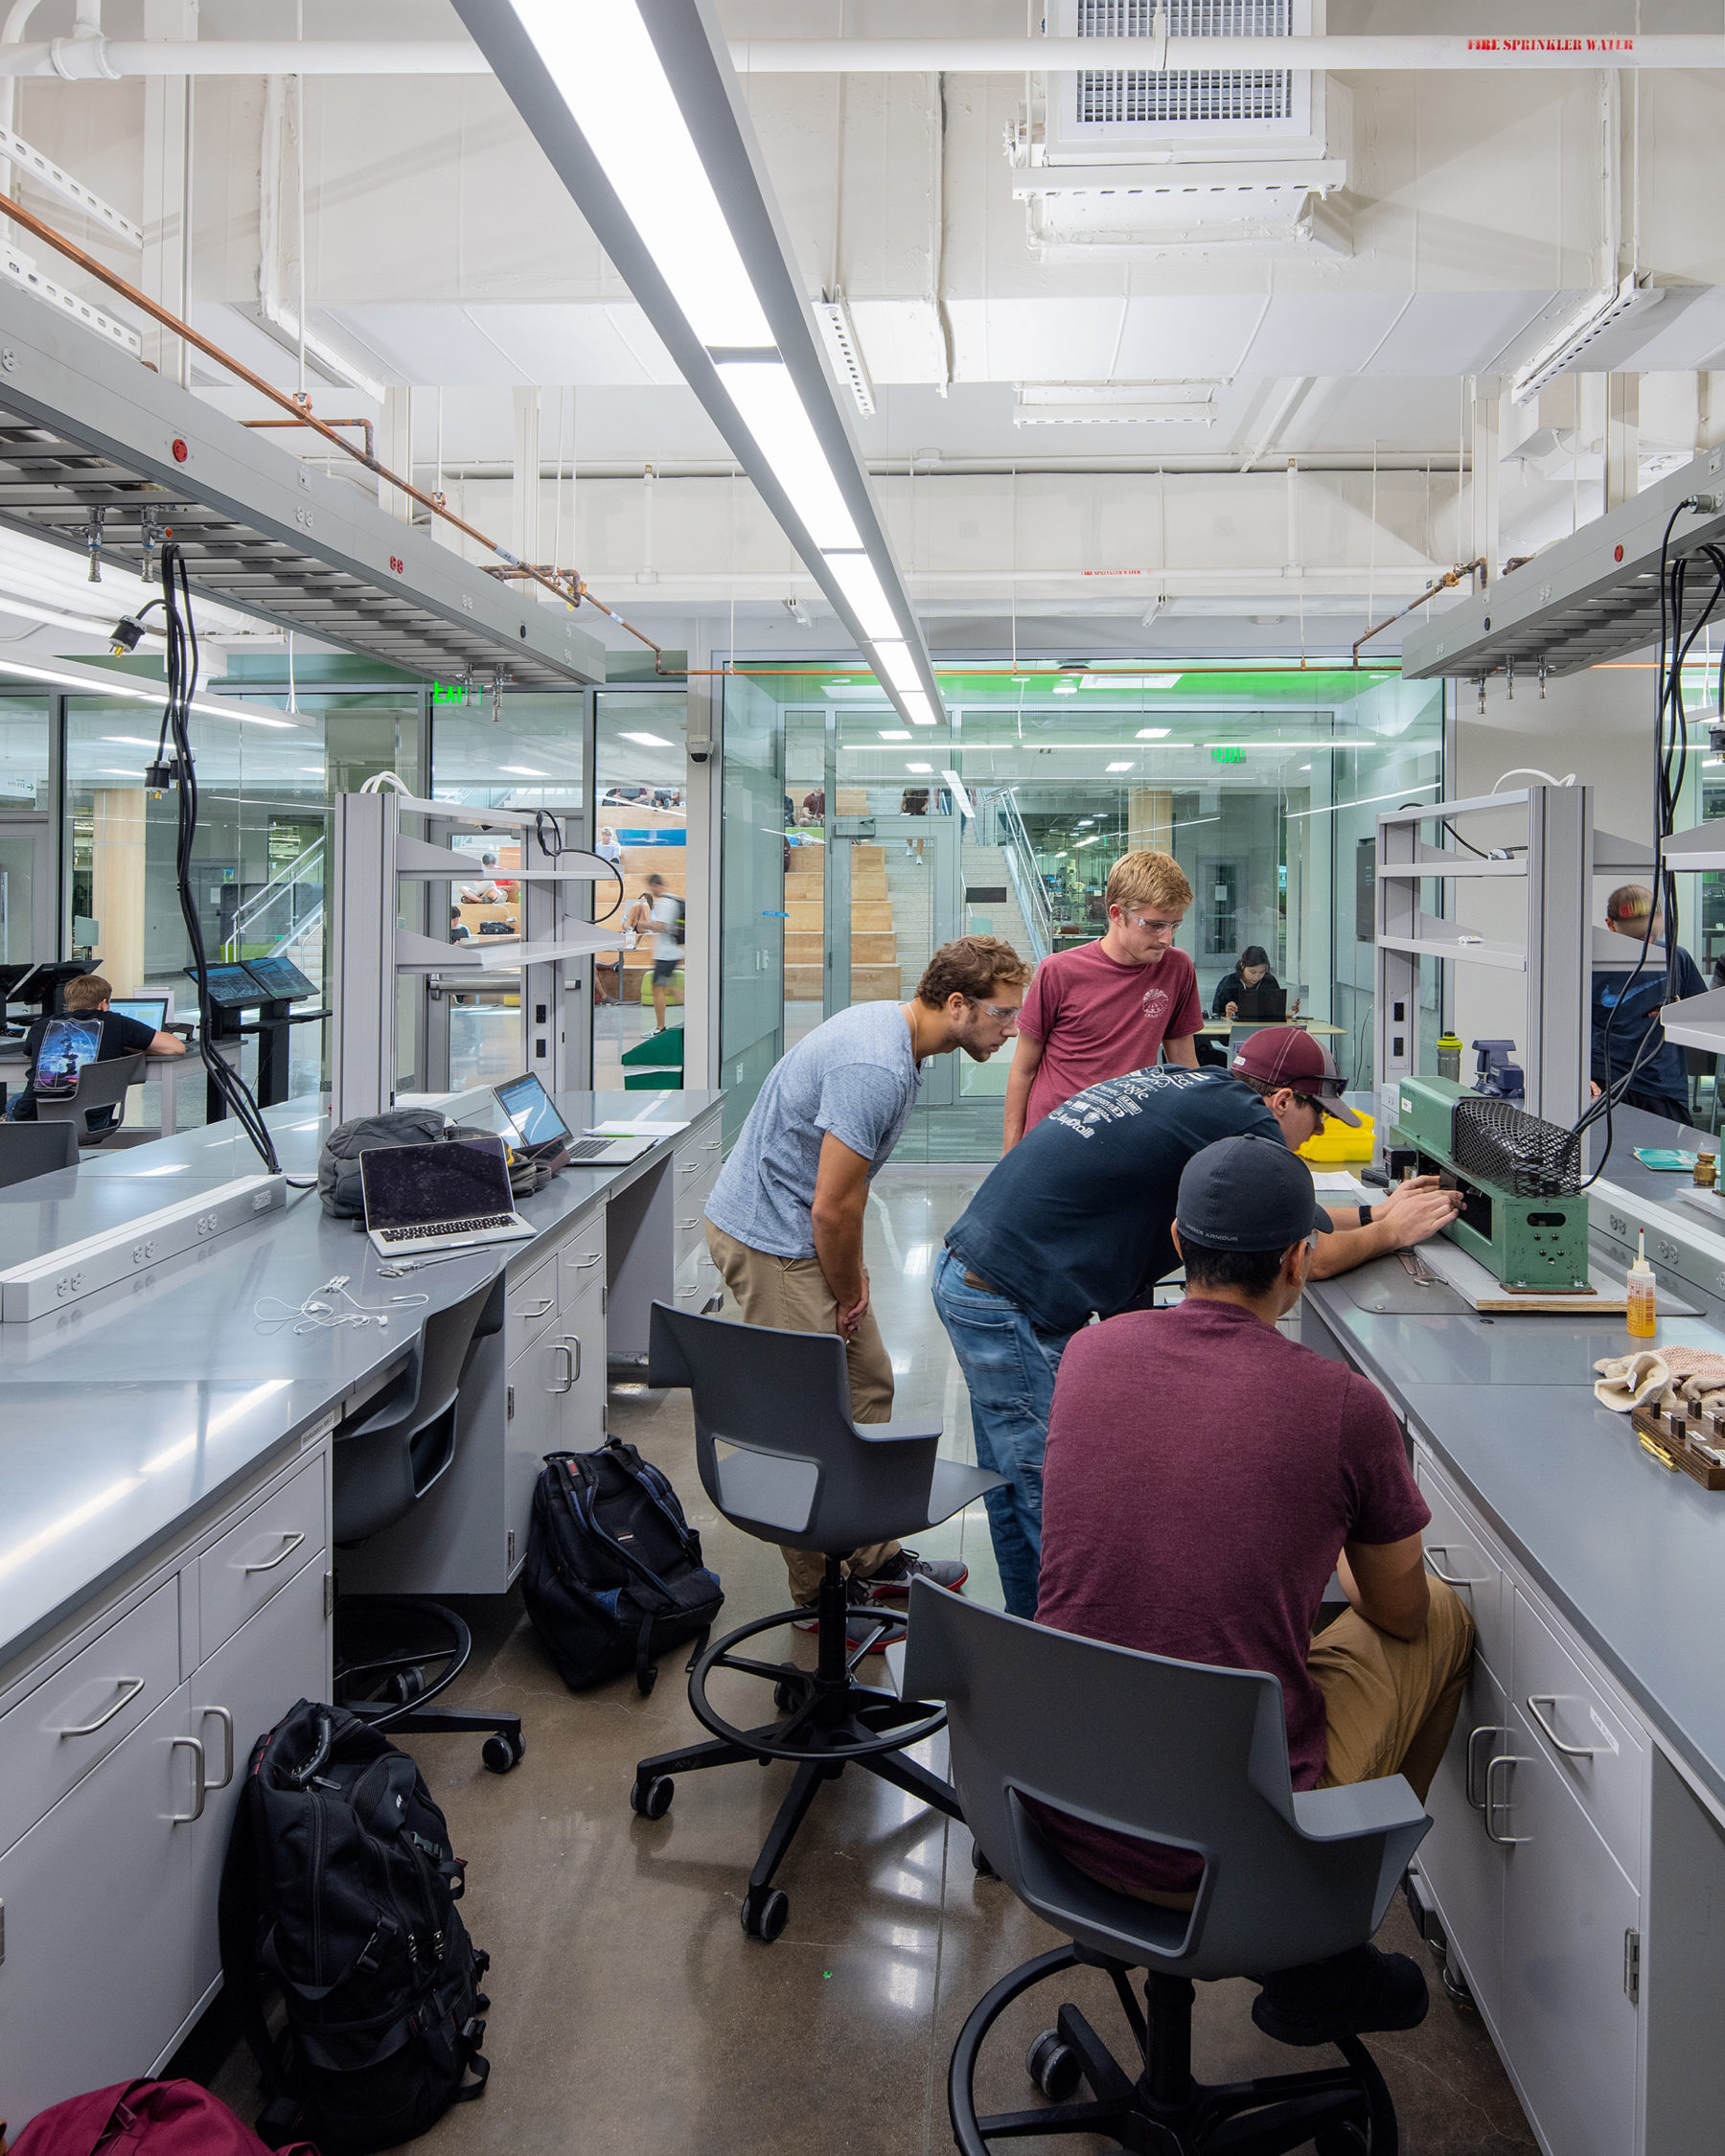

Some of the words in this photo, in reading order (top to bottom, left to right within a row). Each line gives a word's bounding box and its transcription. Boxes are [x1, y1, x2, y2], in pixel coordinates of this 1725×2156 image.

[1467, 39, 1500, 51] FIRE
[1503, 39, 1582, 51] SPRINKLER
[1586, 39, 1633, 51] WATER
[434, 680, 469, 703] EXI
[1114, 1079, 1149, 1100] Google
[1206, 1232, 1238, 1242] ARMOUR
